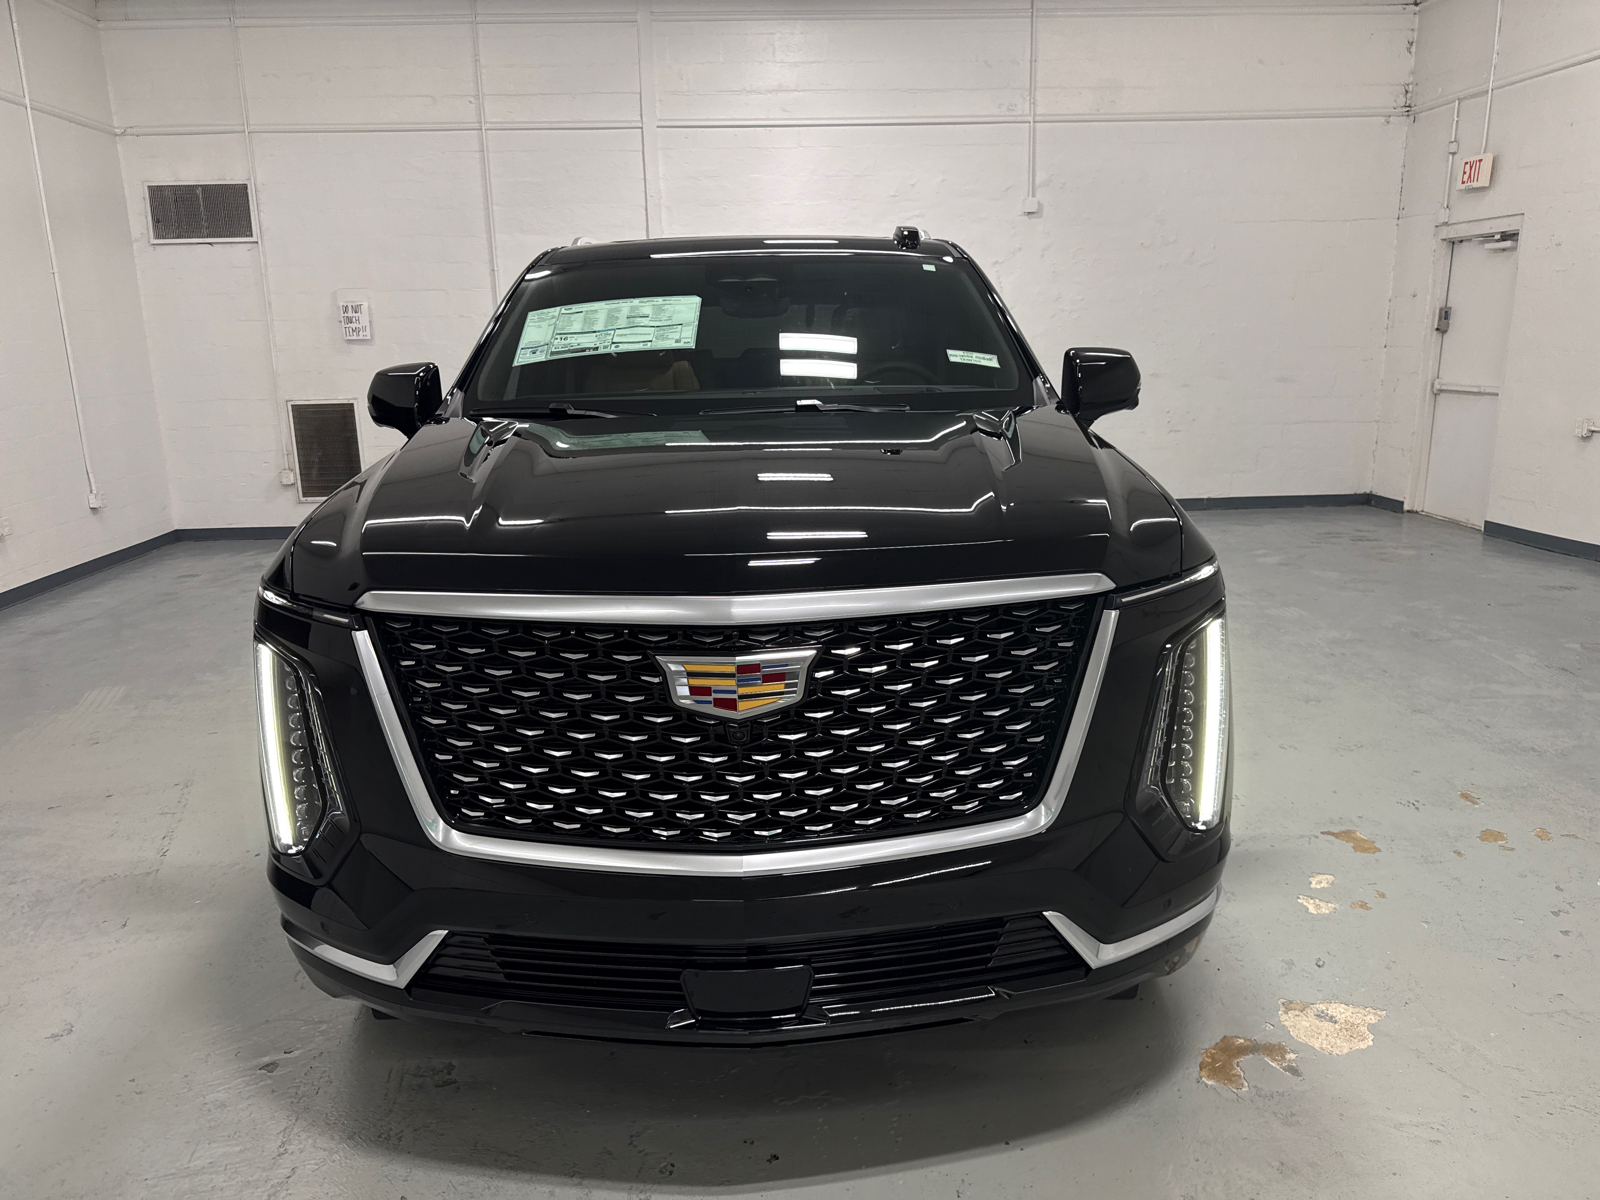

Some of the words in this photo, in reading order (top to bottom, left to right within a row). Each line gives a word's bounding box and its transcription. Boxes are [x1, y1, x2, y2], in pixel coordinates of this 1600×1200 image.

[1461, 158, 1483, 184] EXIT
[342, 304, 349, 315] DO
[351, 303, 363, 315] NOT
[342, 315, 361, 325] TOUCH
[344, 325, 368, 337] TEMP!!
